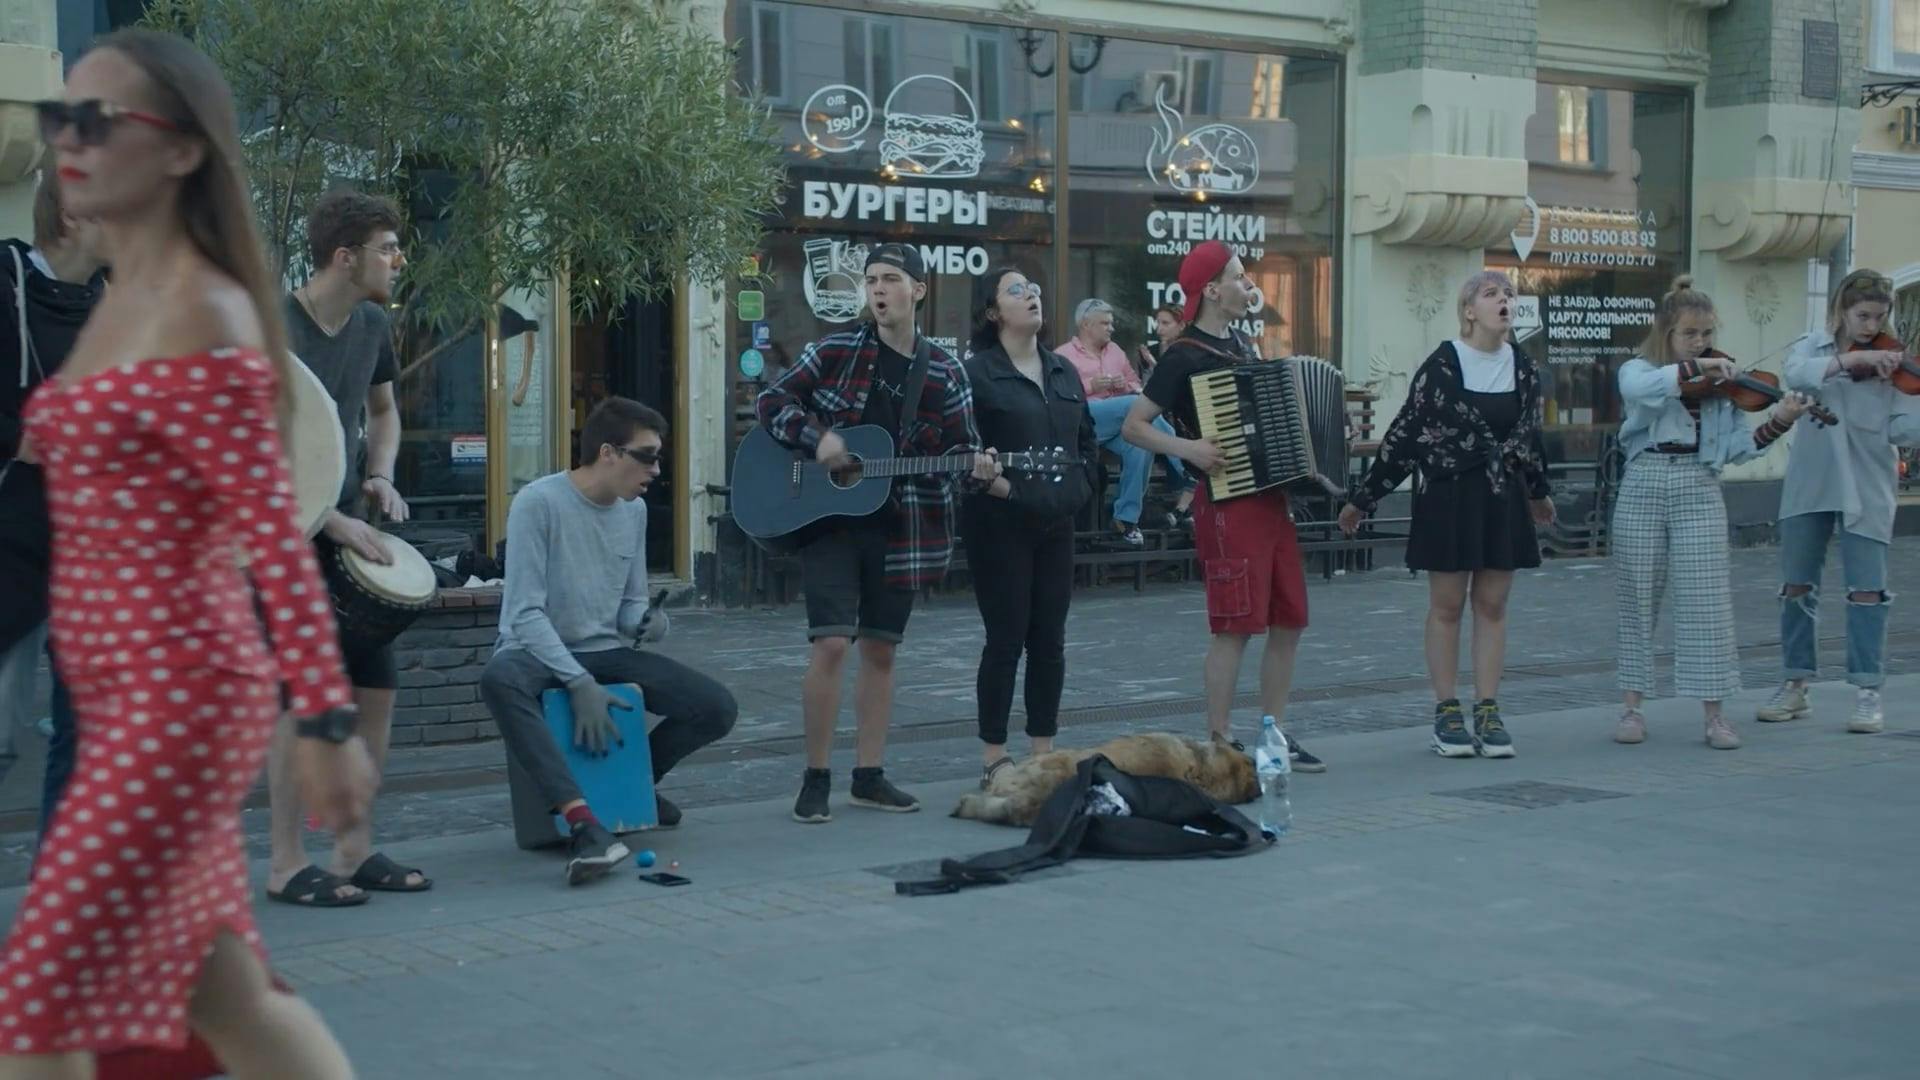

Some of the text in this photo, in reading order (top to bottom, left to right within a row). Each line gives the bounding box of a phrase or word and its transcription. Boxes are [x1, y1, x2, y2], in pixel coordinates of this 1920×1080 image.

[826, 95, 848, 107] от
[803, 180, 988, 226] БУРГЕРЫ
[1146, 205, 1266, 243] СТЕЙКИ
[1550, 227, 1657, 248] 8 800 500 83 93
[875, 243, 989, 276] МБО
[1550, 251, 1657, 266] myasoroob.ru
[1549, 295, 1656, 310] НЕ ЗАБУДЬ ОФОРМИТЬ
[1549, 311, 1656, 326] КАРТУ ЛОЯЛЬНОСТИ
